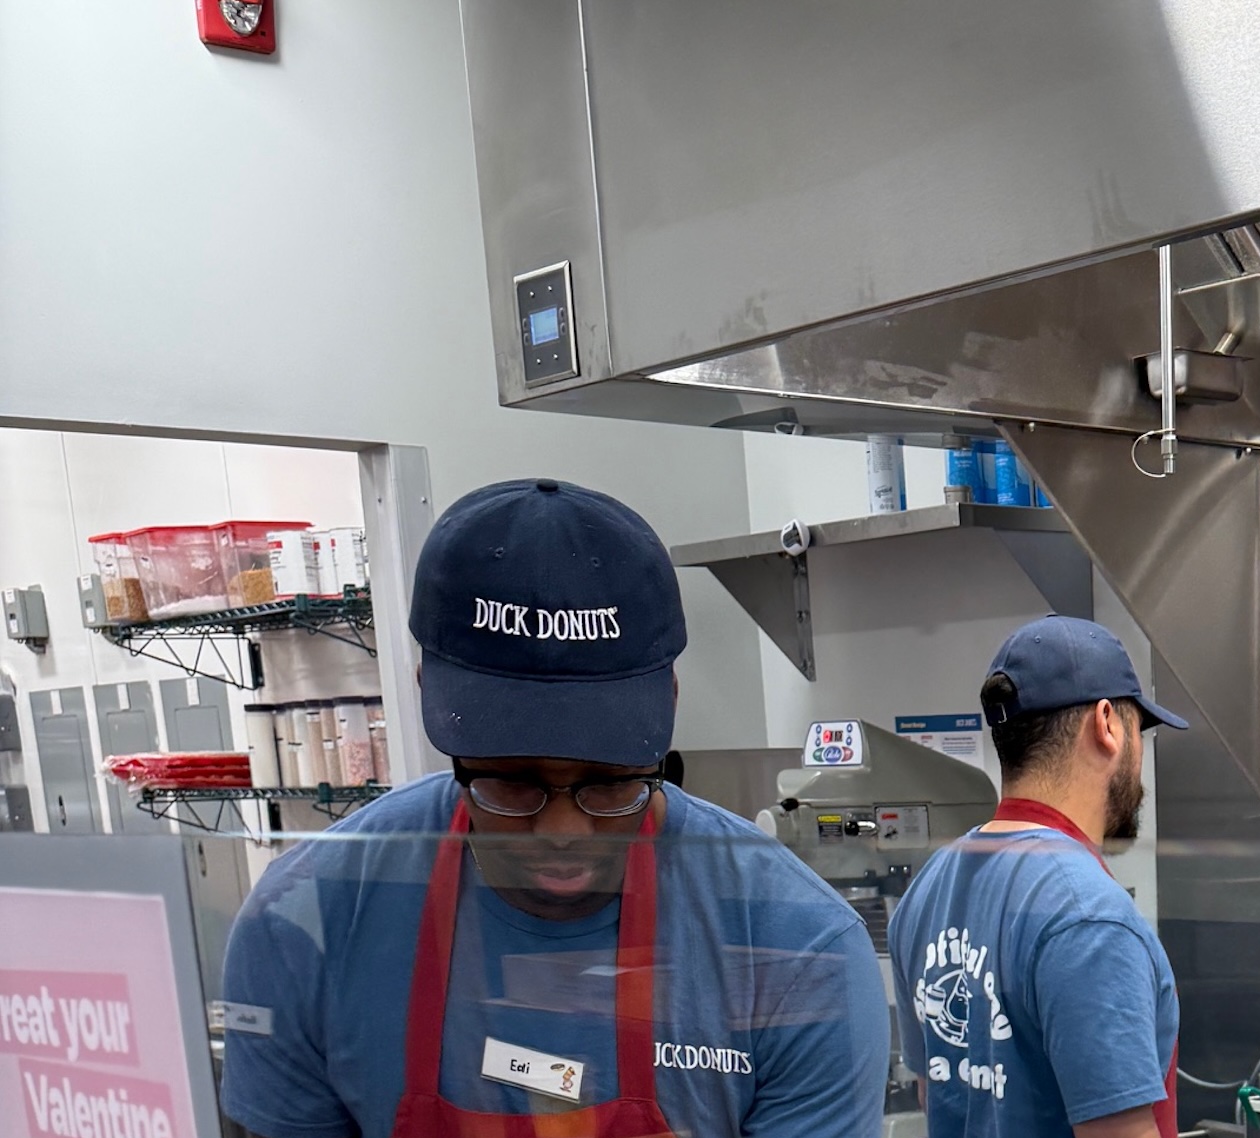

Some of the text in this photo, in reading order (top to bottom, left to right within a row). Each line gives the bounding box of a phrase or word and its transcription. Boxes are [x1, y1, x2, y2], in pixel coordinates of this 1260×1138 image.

[472, 597, 621, 641] DUCK DONUTS
[0, 985, 130, 1062] reat your
[510, 1059, 531, 1075] Edi
[685, 1046, 753, 1075] DONUTS
